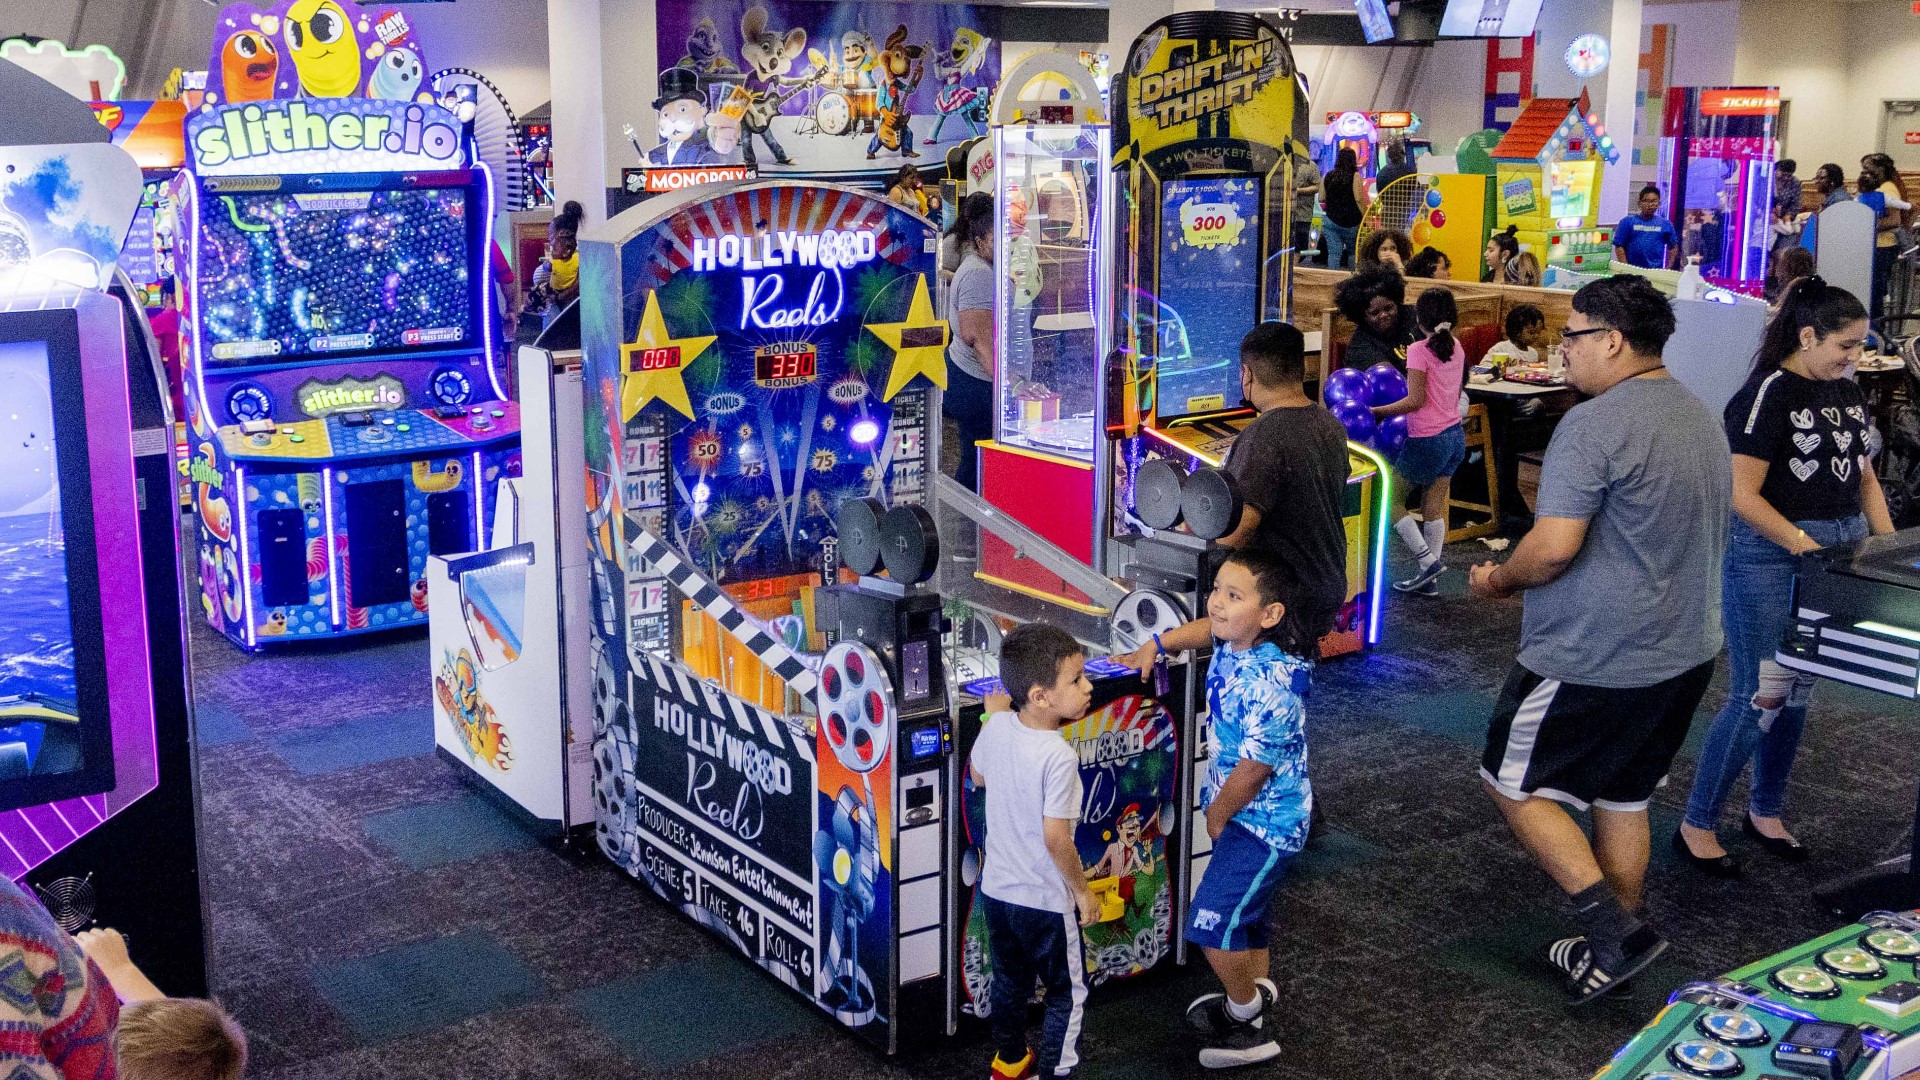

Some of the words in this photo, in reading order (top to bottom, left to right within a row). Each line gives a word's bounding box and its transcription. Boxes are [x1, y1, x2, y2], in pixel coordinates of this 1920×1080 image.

[375, 11, 405, 39] RAW
[1140, 54, 1228, 105] DRIFT
[1155, 74, 1258, 130] THRIFT
[196, 103, 459, 165] slither.io
[1202, 147, 1254, 159] TICKETS
[651, 170, 744, 189] MONOPOLY
[1192, 215, 1226, 231] 300
[692, 228, 877, 272] HOLLYWOOD
[740, 266, 844, 330] Reels
[642, 348, 680, 369] 000
[763, 343, 808, 355] BONUS
[771, 354, 813, 378] 330
[764, 376, 808, 388] BONUS
[835, 386, 862, 398] BONUS
[304, 385, 401, 412] slither.io
[709, 397, 740, 414] BONUS
[894, 395, 916, 404] TICKET
[893, 418, 916, 427] BONUS
[698, 443, 717, 456] 50
[743, 462, 762, 476] 75
[815, 454, 833, 468] 75
[723, 511, 736, 521] 25
[633, 617, 659, 627] TICKET
[654, 696, 792, 795] HOLLYWOOD
[686, 753, 764, 841] Reels
[637, 795, 690, 852] PRODUCER:
[690, 833, 731, 876] Jennison
[731, 856, 814, 930] Entertainment
[645, 846, 680, 890] SCENE:
[682, 869, 693, 902] 5
[701, 882, 732, 926] TAKE:
[736, 905, 754, 938] 16
[765, 923, 799, 970] ROLL:
[800, 950, 812, 977] 6
